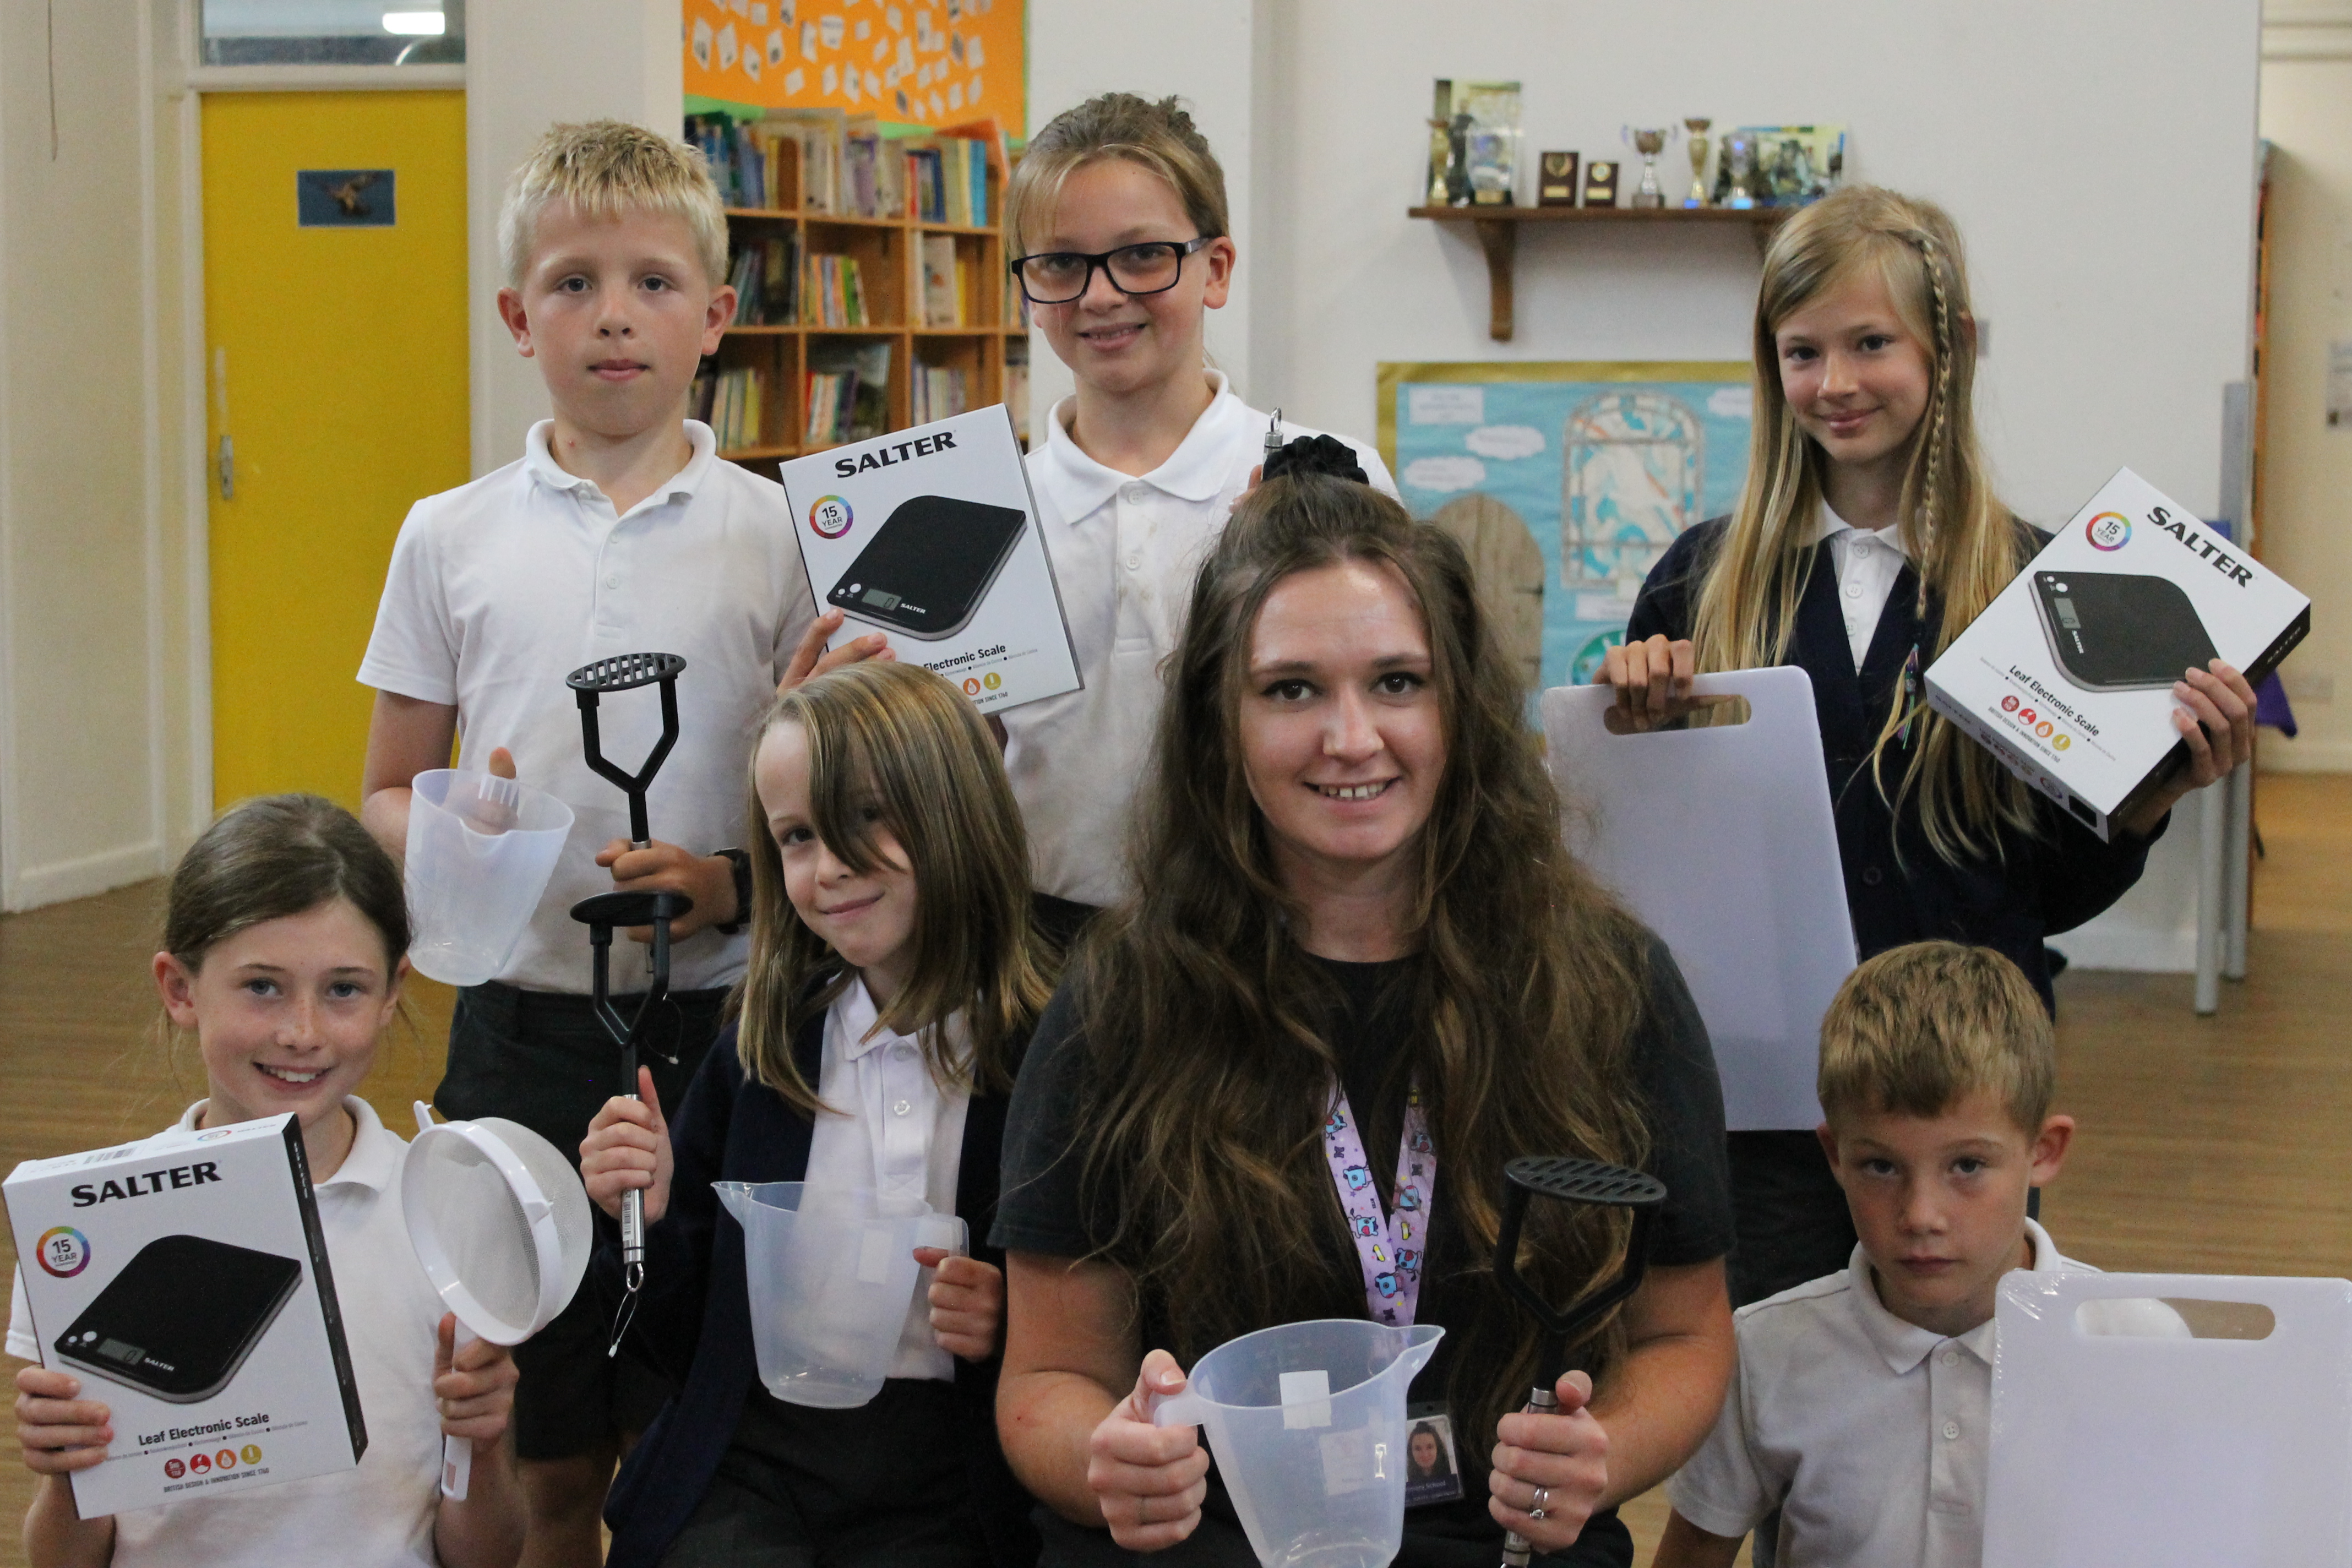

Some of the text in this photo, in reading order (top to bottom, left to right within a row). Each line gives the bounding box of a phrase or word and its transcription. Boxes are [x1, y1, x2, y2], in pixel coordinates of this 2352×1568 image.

[835, 431, 957, 478] SALTER
[822, 505, 837, 519] 15
[822, 517, 842, 527] YEAR
[2105, 521, 2120, 535] 15
[2097, 527, 2114, 542] YEAR
[2147, 506, 2254, 588] SALTER
[900, 603, 926, 614] SALTER
[2072, 630, 2084, 654] SALTER
[924, 652, 976, 671] Electronic
[978, 645, 1006, 658] Scale
[985, 694, 997, 703] SINCE
[2010, 665, 2032, 684] Leaf
[2030, 681, 2074, 717] Electronic
[2075, 715, 2099, 736] Scale
[70, 1162, 222, 1207] SALTER
[52, 1239, 71, 1253] 15
[51, 1253, 77, 1262] YEAR
[144, 1357, 175, 1371] SALTER
[139, 1430, 165, 1446] Leaf
[170, 1419, 232, 1440] Electronic
[236, 1413, 270, 1428] Scale
